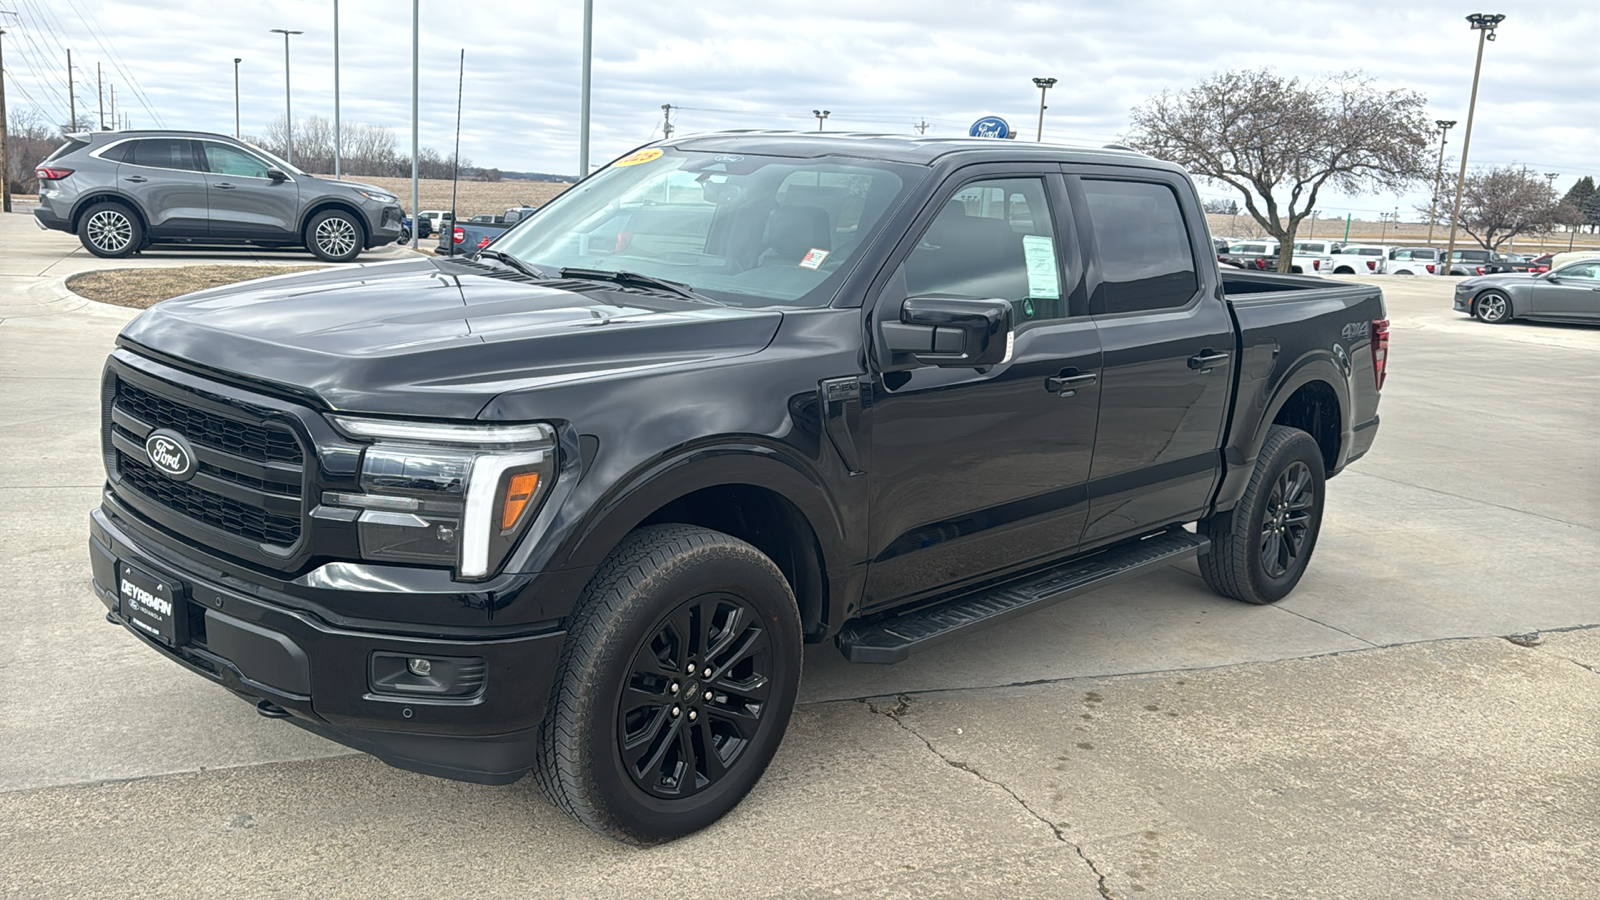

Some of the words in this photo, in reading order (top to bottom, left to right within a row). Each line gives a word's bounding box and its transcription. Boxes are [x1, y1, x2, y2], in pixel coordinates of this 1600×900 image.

[976, 122, 1002, 138] Ford
[153, 439, 181, 470] Ford
[121, 578, 172, 617] DEYARMAN
